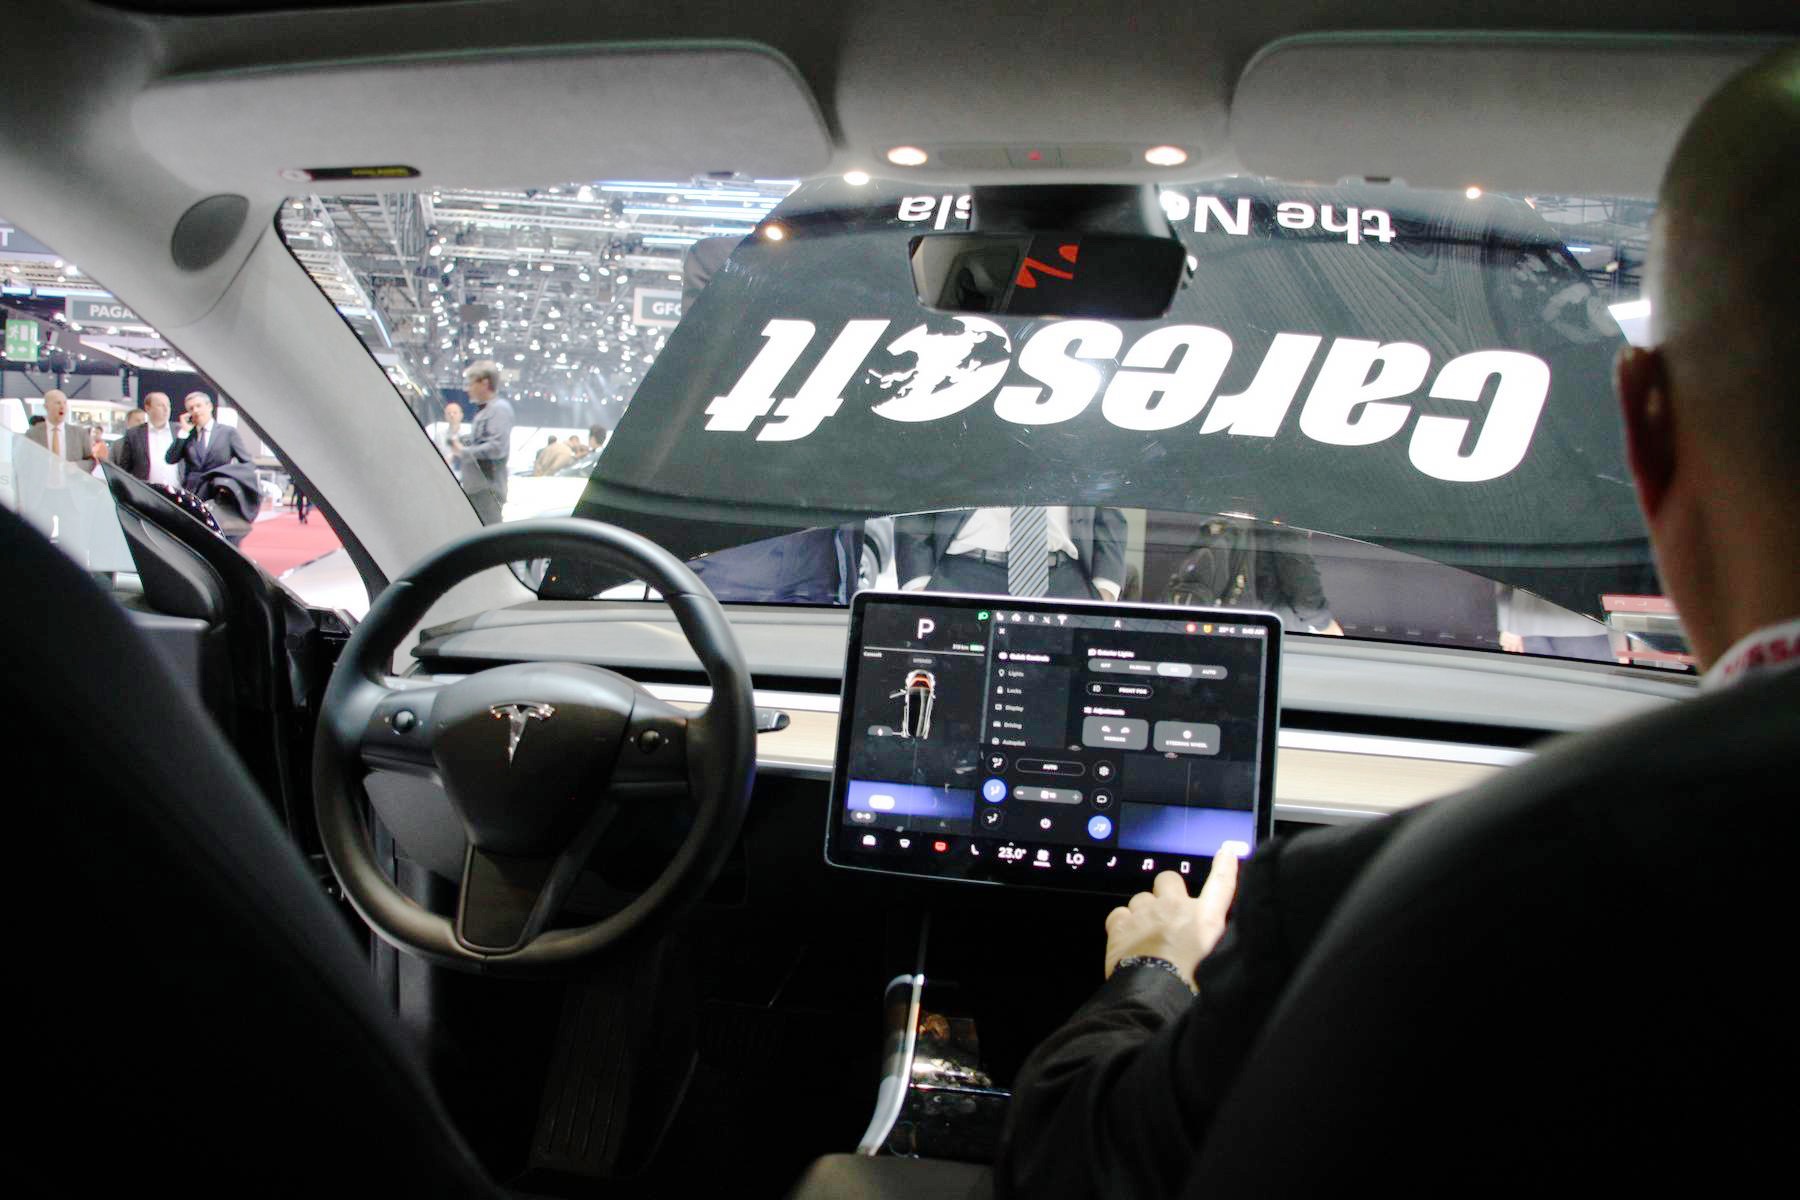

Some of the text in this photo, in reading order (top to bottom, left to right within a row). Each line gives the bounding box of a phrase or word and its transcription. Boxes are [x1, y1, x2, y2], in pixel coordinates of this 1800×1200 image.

[1276, 202, 1397, 245] the
[703, 315, 1551, 483] Caresoft
[916, 617, 936, 640] P
[1065, 852, 1085, 865] LO
